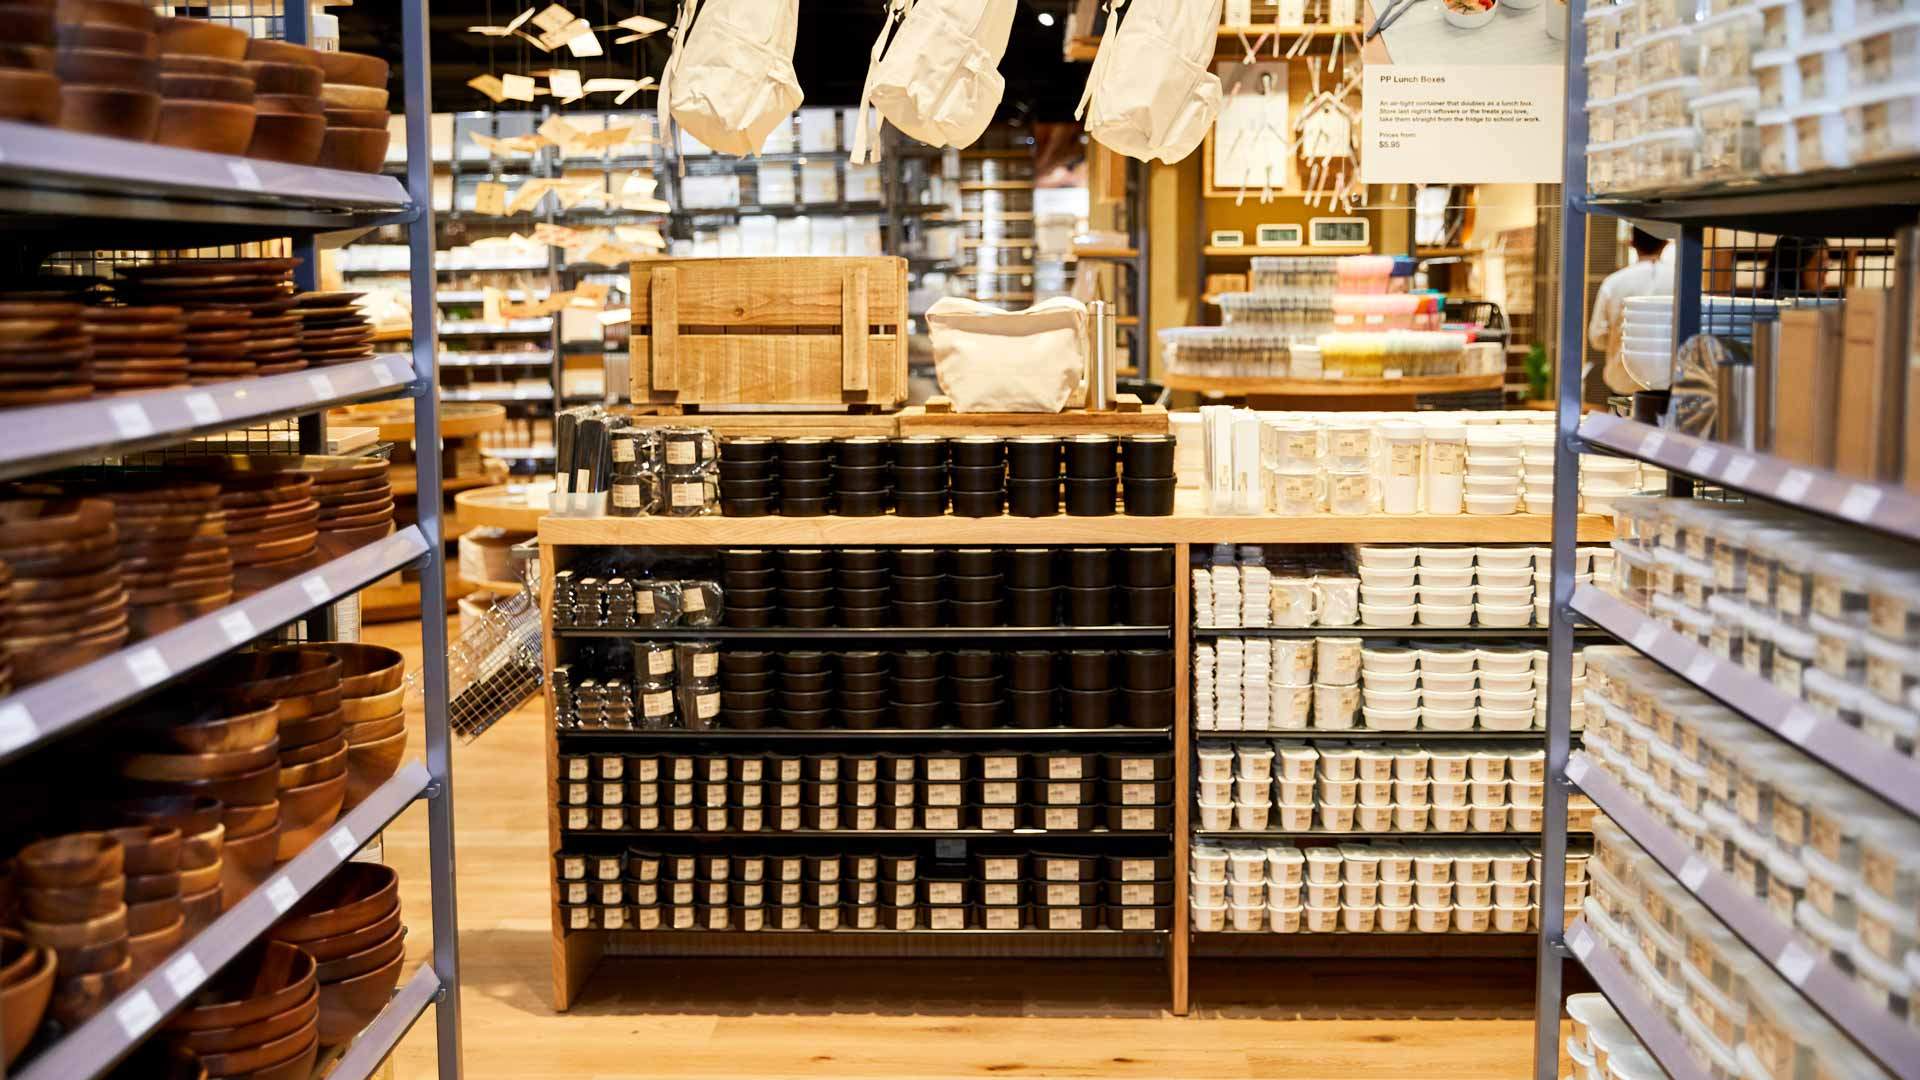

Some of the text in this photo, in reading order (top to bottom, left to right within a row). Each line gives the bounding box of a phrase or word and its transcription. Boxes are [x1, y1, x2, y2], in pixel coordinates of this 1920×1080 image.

[1380, 75, 1446, 83] PP Lunch Boxes
